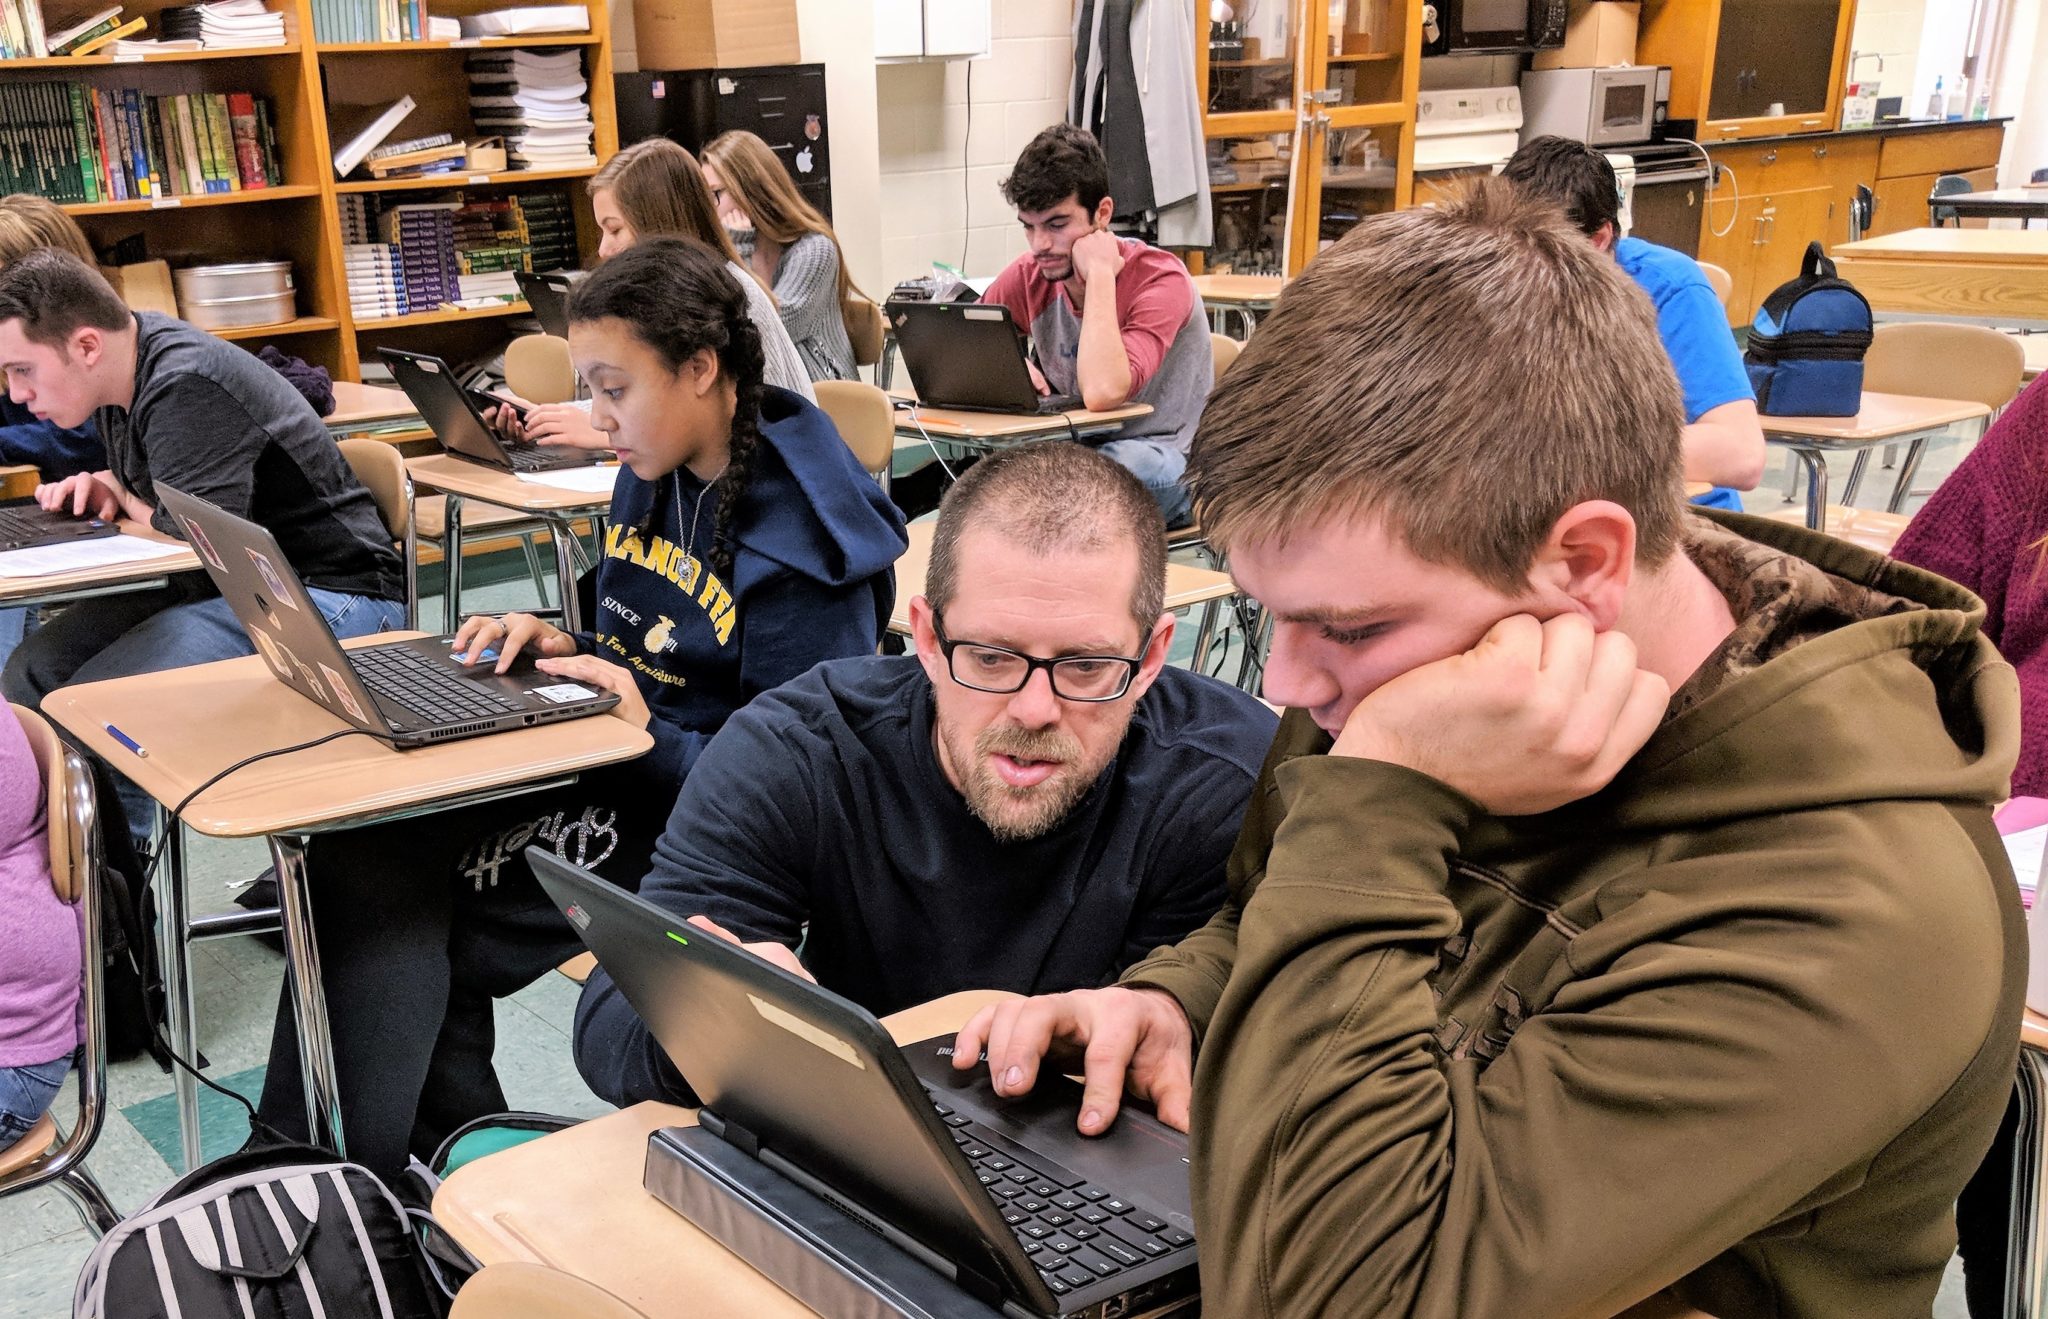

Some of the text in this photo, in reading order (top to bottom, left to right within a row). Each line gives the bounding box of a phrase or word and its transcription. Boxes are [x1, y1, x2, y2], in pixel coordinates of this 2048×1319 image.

[601, 596, 642, 626] SINCE
[697, 571, 737, 647] FFA
[606, 636, 627, 656] For
